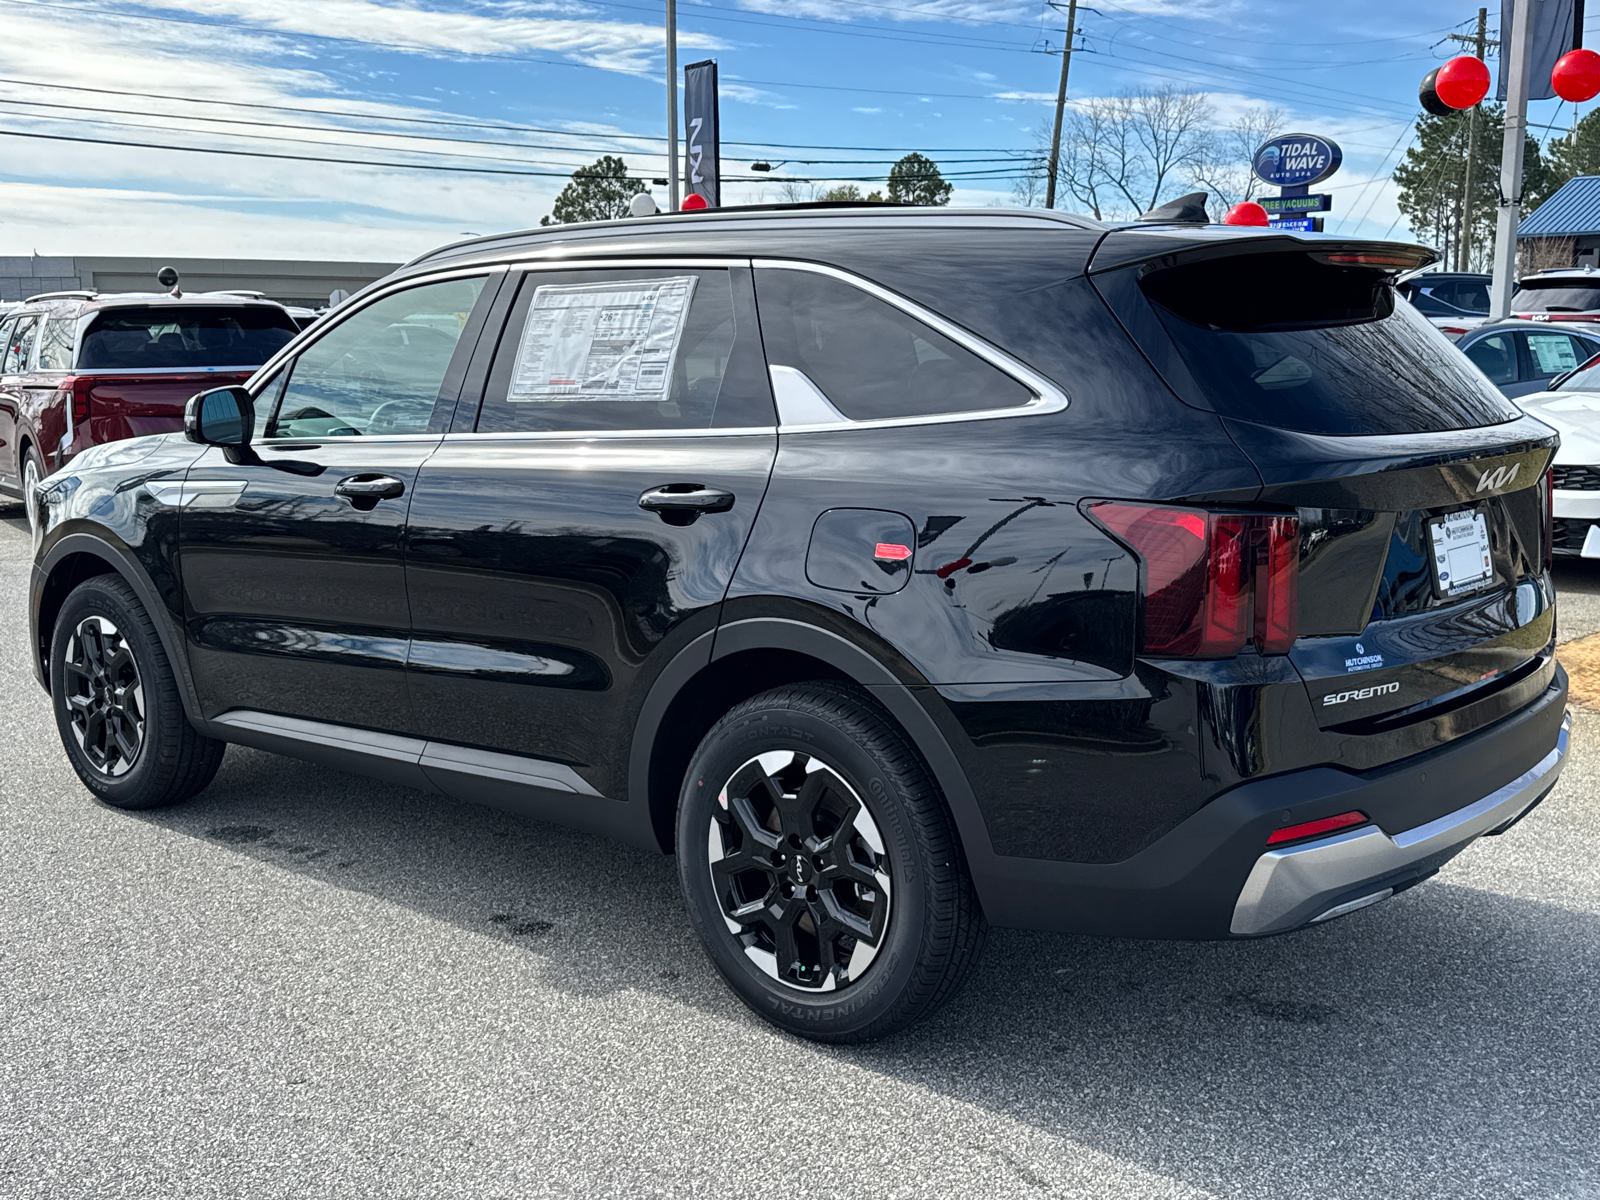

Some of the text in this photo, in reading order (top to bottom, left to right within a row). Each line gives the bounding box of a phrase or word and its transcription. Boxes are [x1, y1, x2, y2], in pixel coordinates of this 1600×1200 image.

[1281, 142, 1318, 157] TIDAL
[1285, 155, 1325, 170] WAVE
[1260, 197, 1320, 210] FREE VACUUMS
[602, 313, 613, 322] 26
[1476, 462, 1520, 493] KIA
[1345, 654, 1383, 667] HUTCHINSON
[1323, 681, 1399, 706] SORENTO
